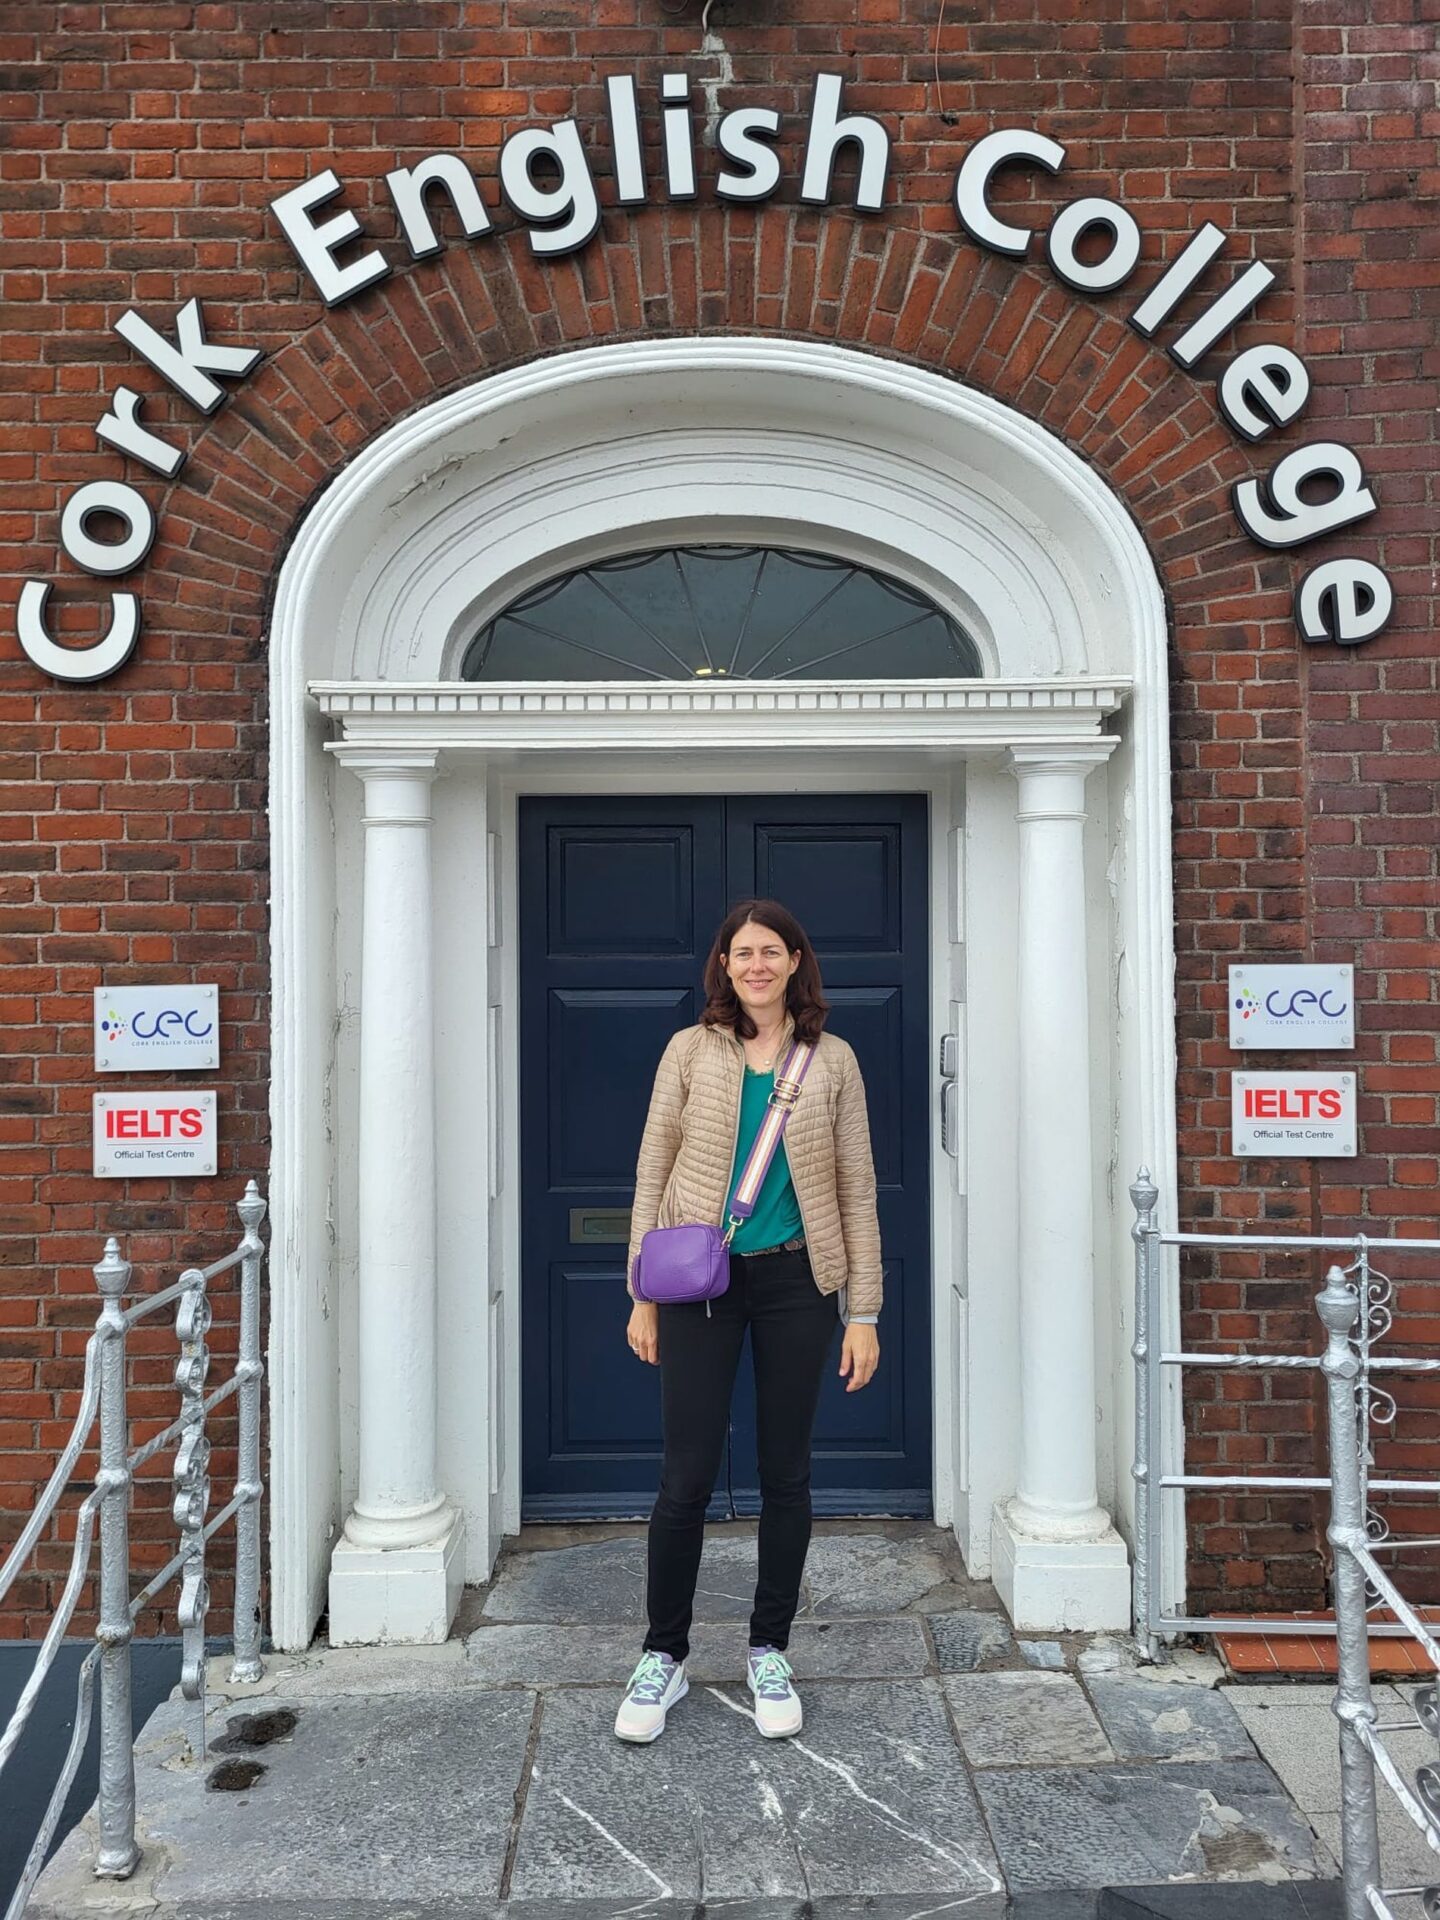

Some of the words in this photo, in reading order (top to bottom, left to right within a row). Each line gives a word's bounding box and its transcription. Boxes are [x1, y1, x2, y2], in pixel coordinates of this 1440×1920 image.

[17, 297, 264, 682] Cork
[270, 73, 890, 306] English
[955, 128, 1394, 645] College
[1244, 1089, 1342, 1119] IELTS
[1253, 1130, 1283, 1139] Official
[1285, 1130, 1304, 1139] Test
[1305, 1130, 1334, 1139] Centre
[114, 1150, 144, 1159] Official
[146, 1150, 165, 1159] Test
[166, 1149, 195, 1159] Centre
